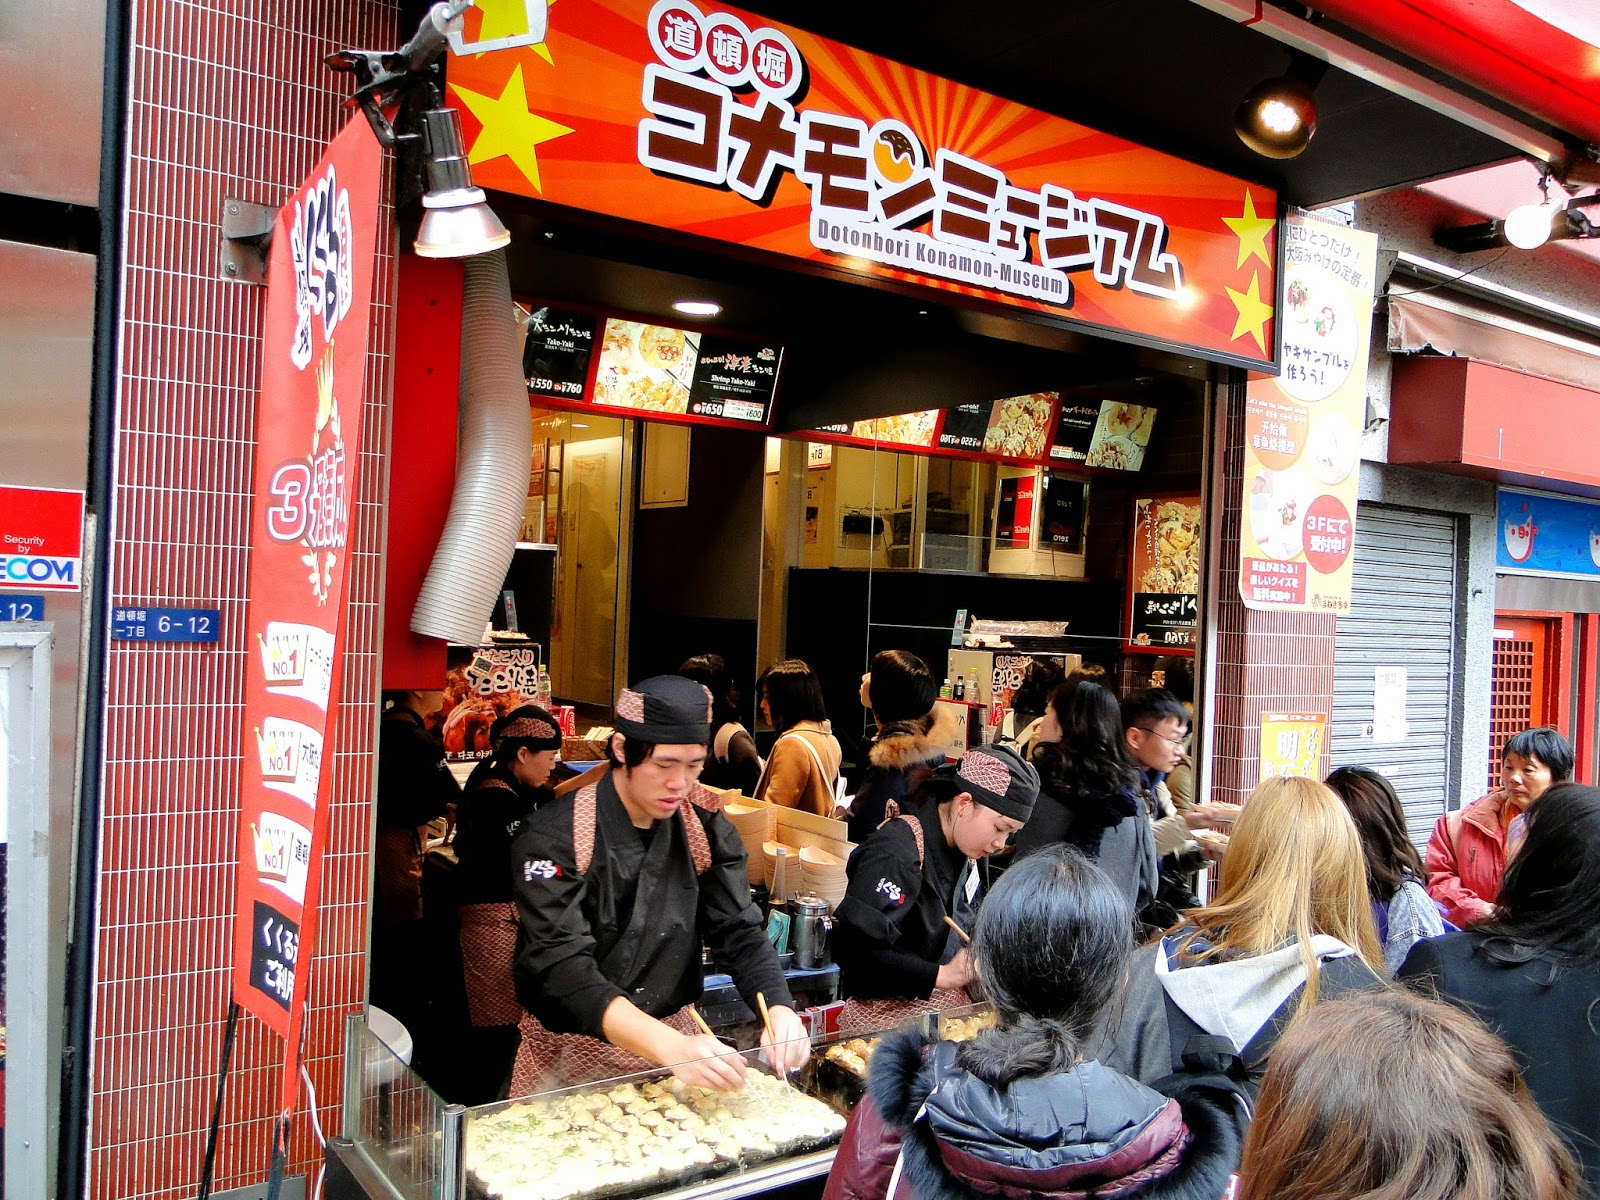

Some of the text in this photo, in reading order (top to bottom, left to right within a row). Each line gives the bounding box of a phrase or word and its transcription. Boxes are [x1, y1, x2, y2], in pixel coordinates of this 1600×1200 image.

[664, 13, 788, 85] 道頓堀
[646, 74, 1178, 292] コナモンミュージアム
[817, 218, 1064, 296] Dotonbori Konamon-Museum
[546, 337, 575, 349] Tako-Yaki
[1306, 515, 1349, 536] 3Fにて
[4, 534, 46, 547] Security
[17, 544, 31, 555] by
[1309, 536, 1346, 555] 受付中!
[116, 610, 147, 622] 道頓堀
[158, 616, 210, 634] 6-12
[115, 626, 146, 638] 一丁目
[272, 650, 298, 675] NO.1
[269, 746, 292, 772] NO.1
[264, 845, 285, 871] NO.1
